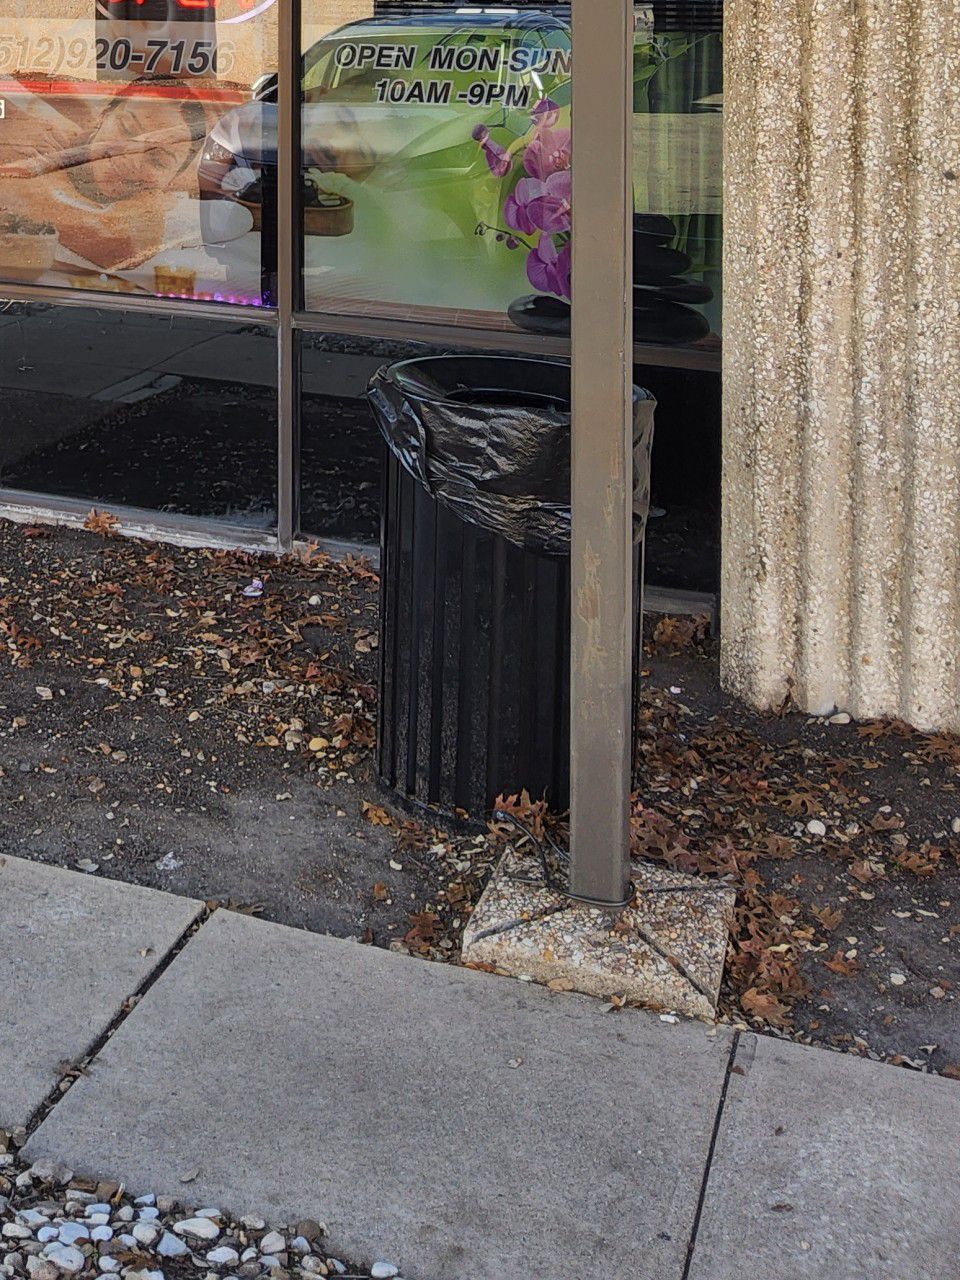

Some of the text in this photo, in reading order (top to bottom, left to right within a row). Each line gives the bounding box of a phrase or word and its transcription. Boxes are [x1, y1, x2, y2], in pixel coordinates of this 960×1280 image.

[335, 43, 417, 70] OPEN
[375, 79, 533, 109] 10AM -9PM
